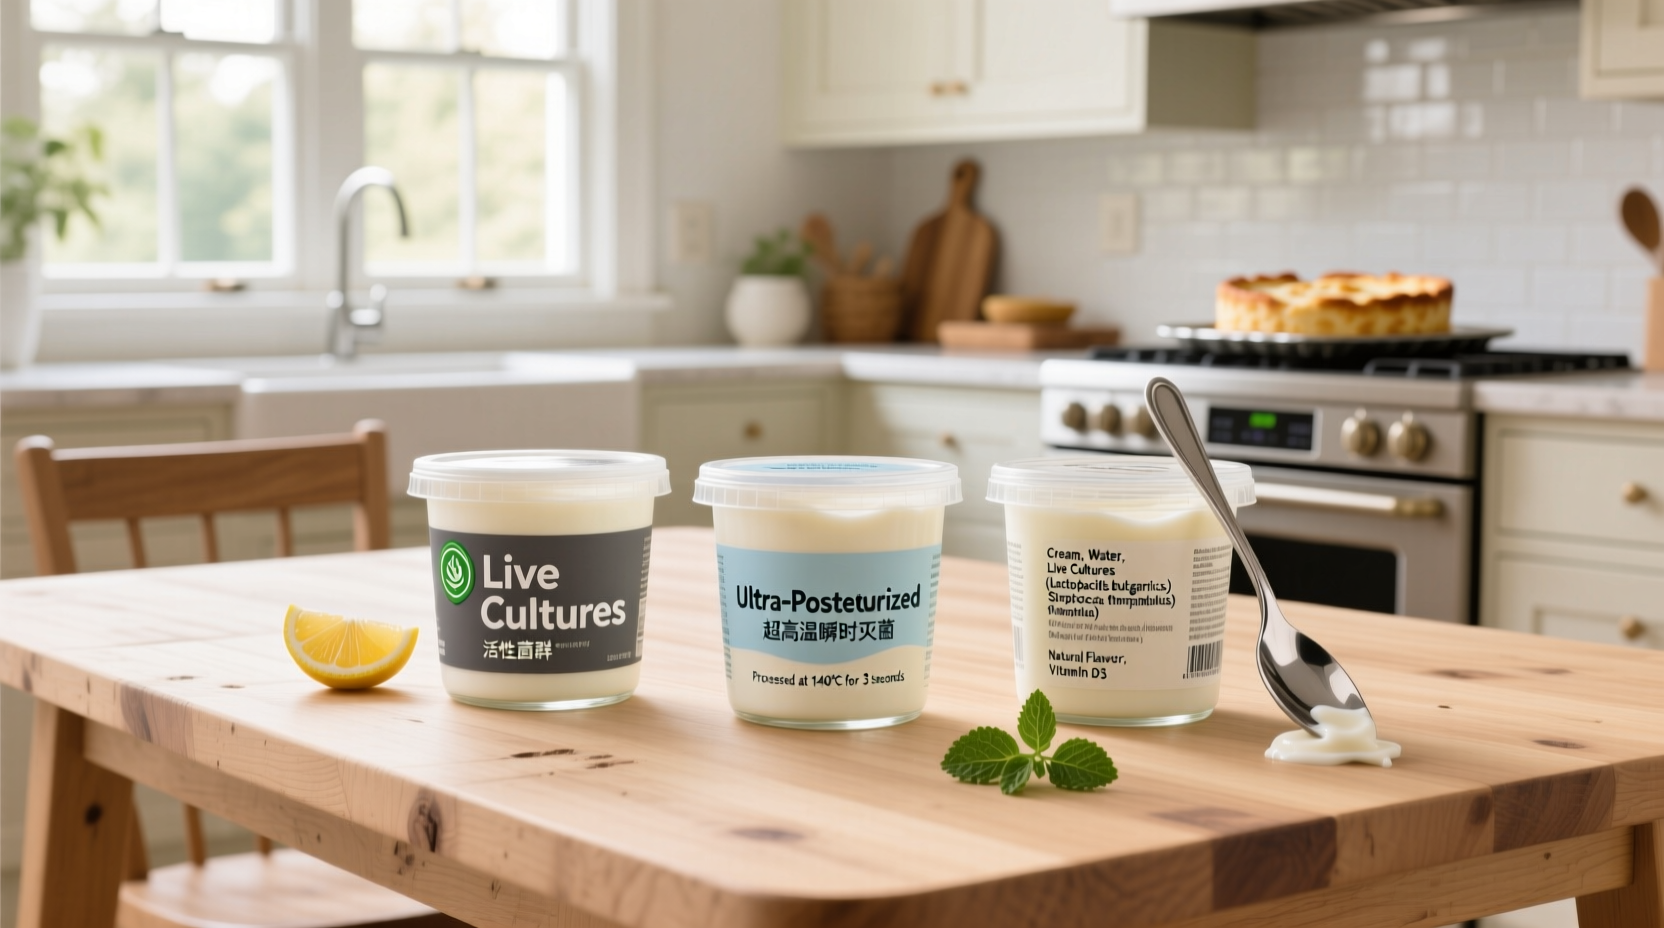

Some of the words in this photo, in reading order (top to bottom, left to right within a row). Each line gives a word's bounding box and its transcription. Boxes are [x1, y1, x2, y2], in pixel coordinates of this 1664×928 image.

[1047, 547, 1084, 562] Cream,
[1088, 549, 1126, 563] Water,
[483, 554, 560, 590] Live
[1070, 563, 1116, 576] Cultures
[480, 595, 626, 630] Cultures
[798, 674, 808, 686] at
[845, 674, 859, 686] for
[863, 673, 869, 685] 3
